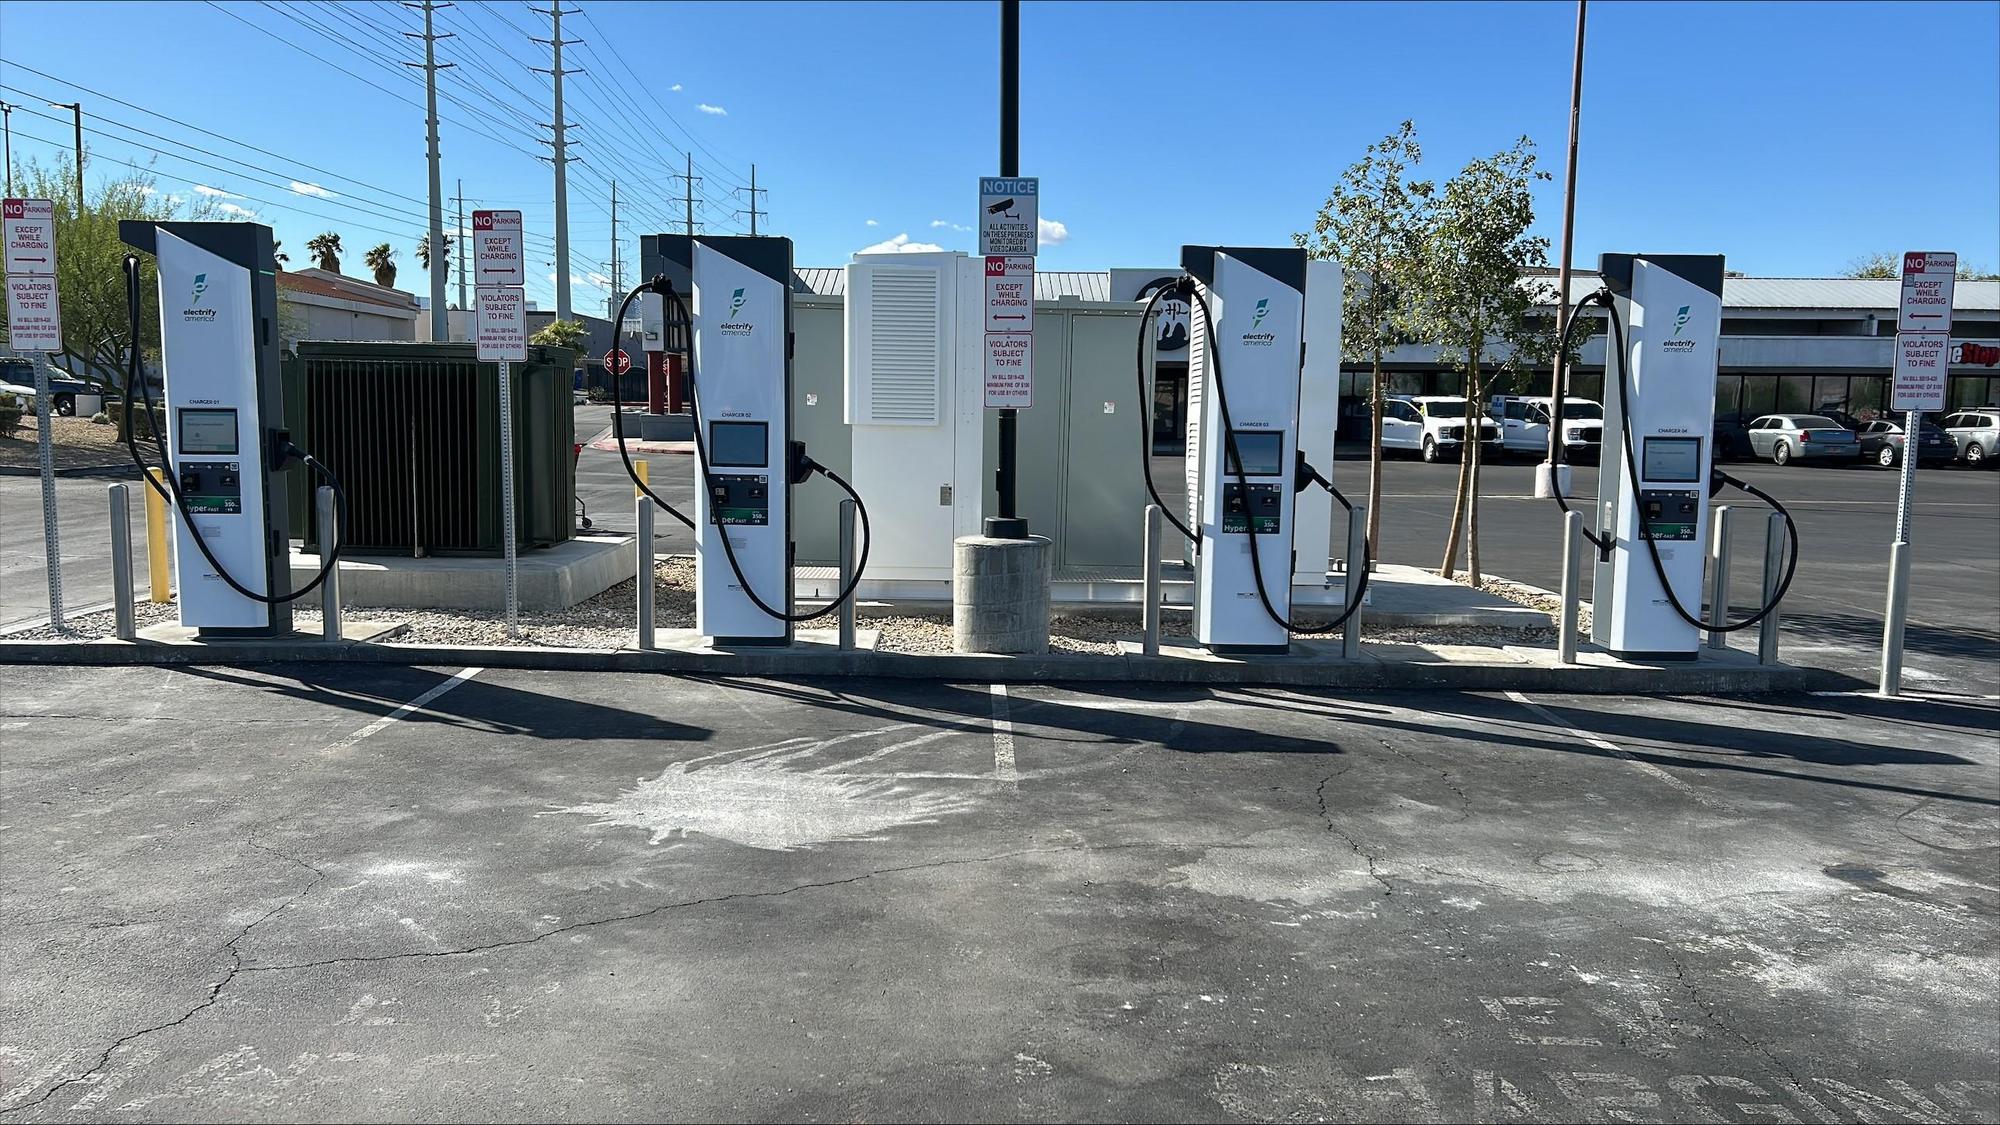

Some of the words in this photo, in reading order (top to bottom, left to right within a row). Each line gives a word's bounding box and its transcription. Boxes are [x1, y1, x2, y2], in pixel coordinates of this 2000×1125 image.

[984, 181, 1035, 193] NOTICE
[5, 204, 22, 214] NO
[475, 217, 491, 226] NO
[988, 263, 1003, 271] NO
[1907, 259, 1924, 268] NO
[606, 357, 628, 367] SOP
[712, 516, 735, 524] Hper
